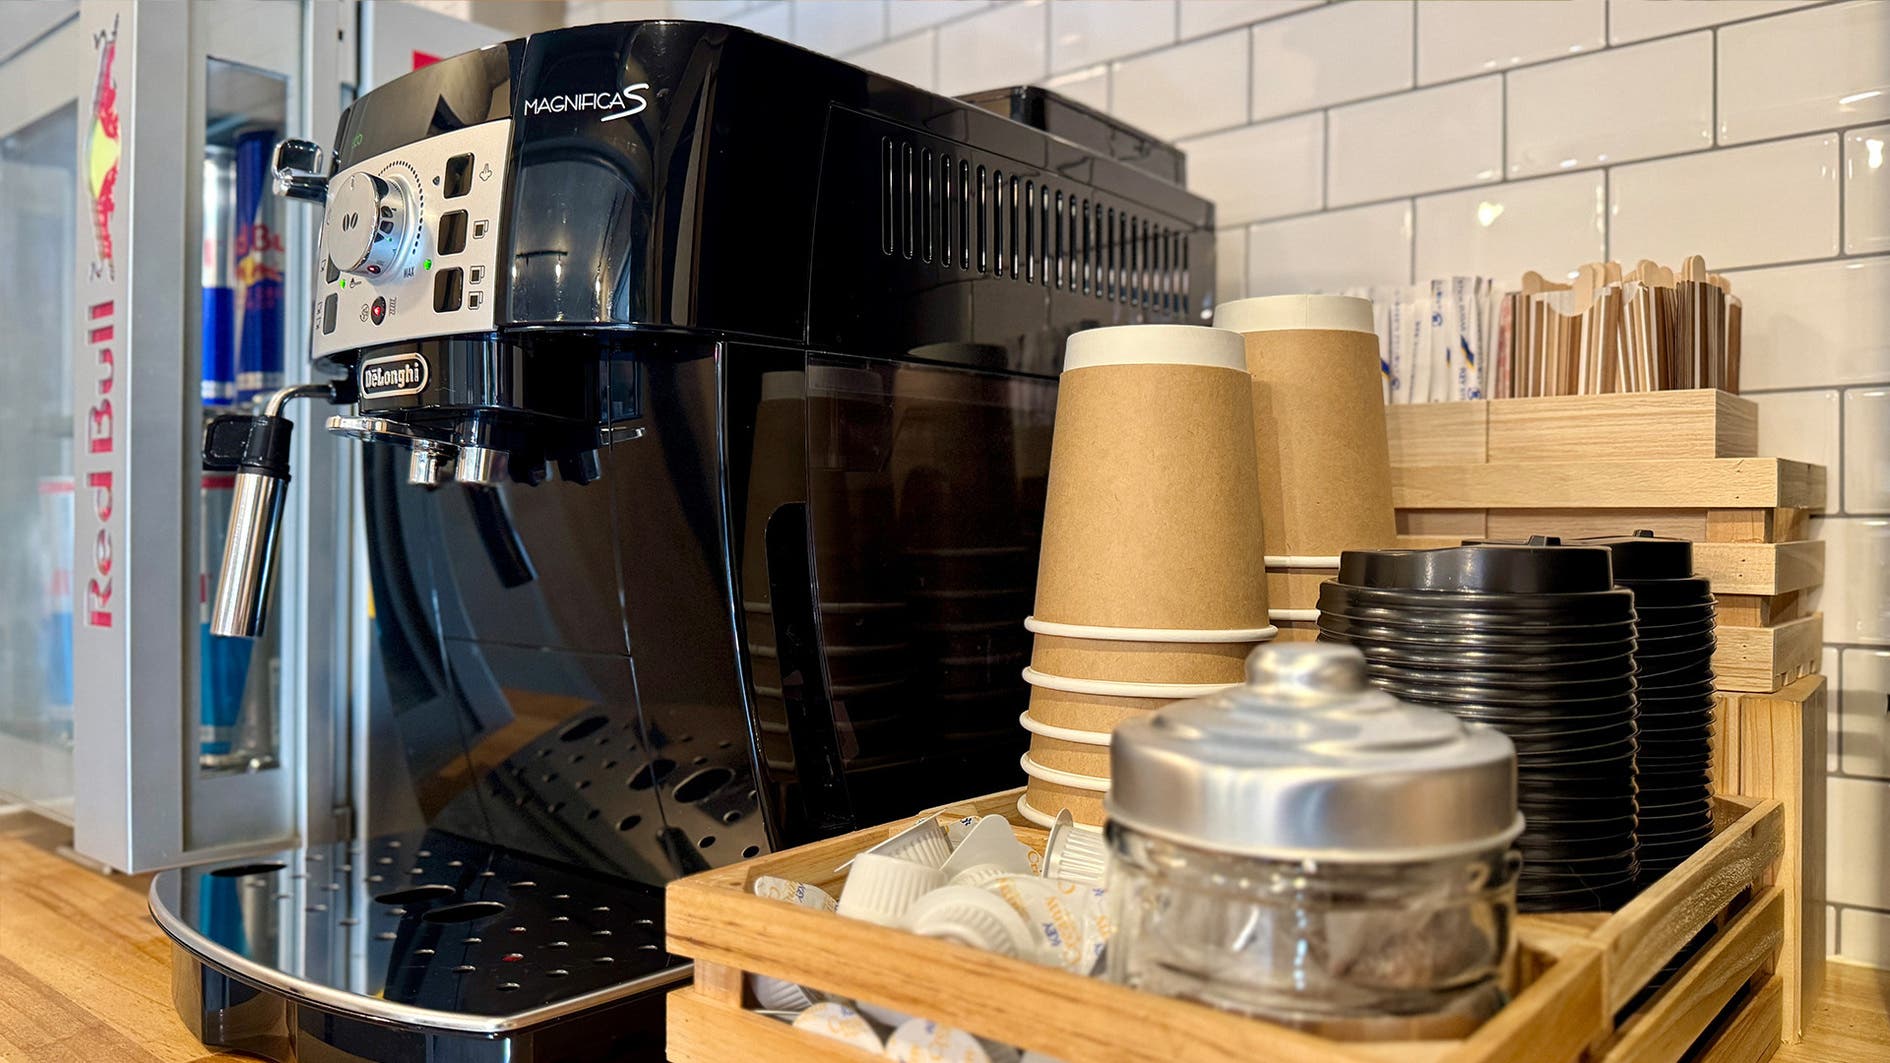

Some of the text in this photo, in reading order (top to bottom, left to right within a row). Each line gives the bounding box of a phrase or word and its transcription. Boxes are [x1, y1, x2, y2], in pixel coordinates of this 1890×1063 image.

[524, 83, 649, 122] MAGNIFICA S
[403, 266, 415, 278] MAX
[87, 300, 115, 628] Red Bull
[1042, 922, 1061, 947] KEY
